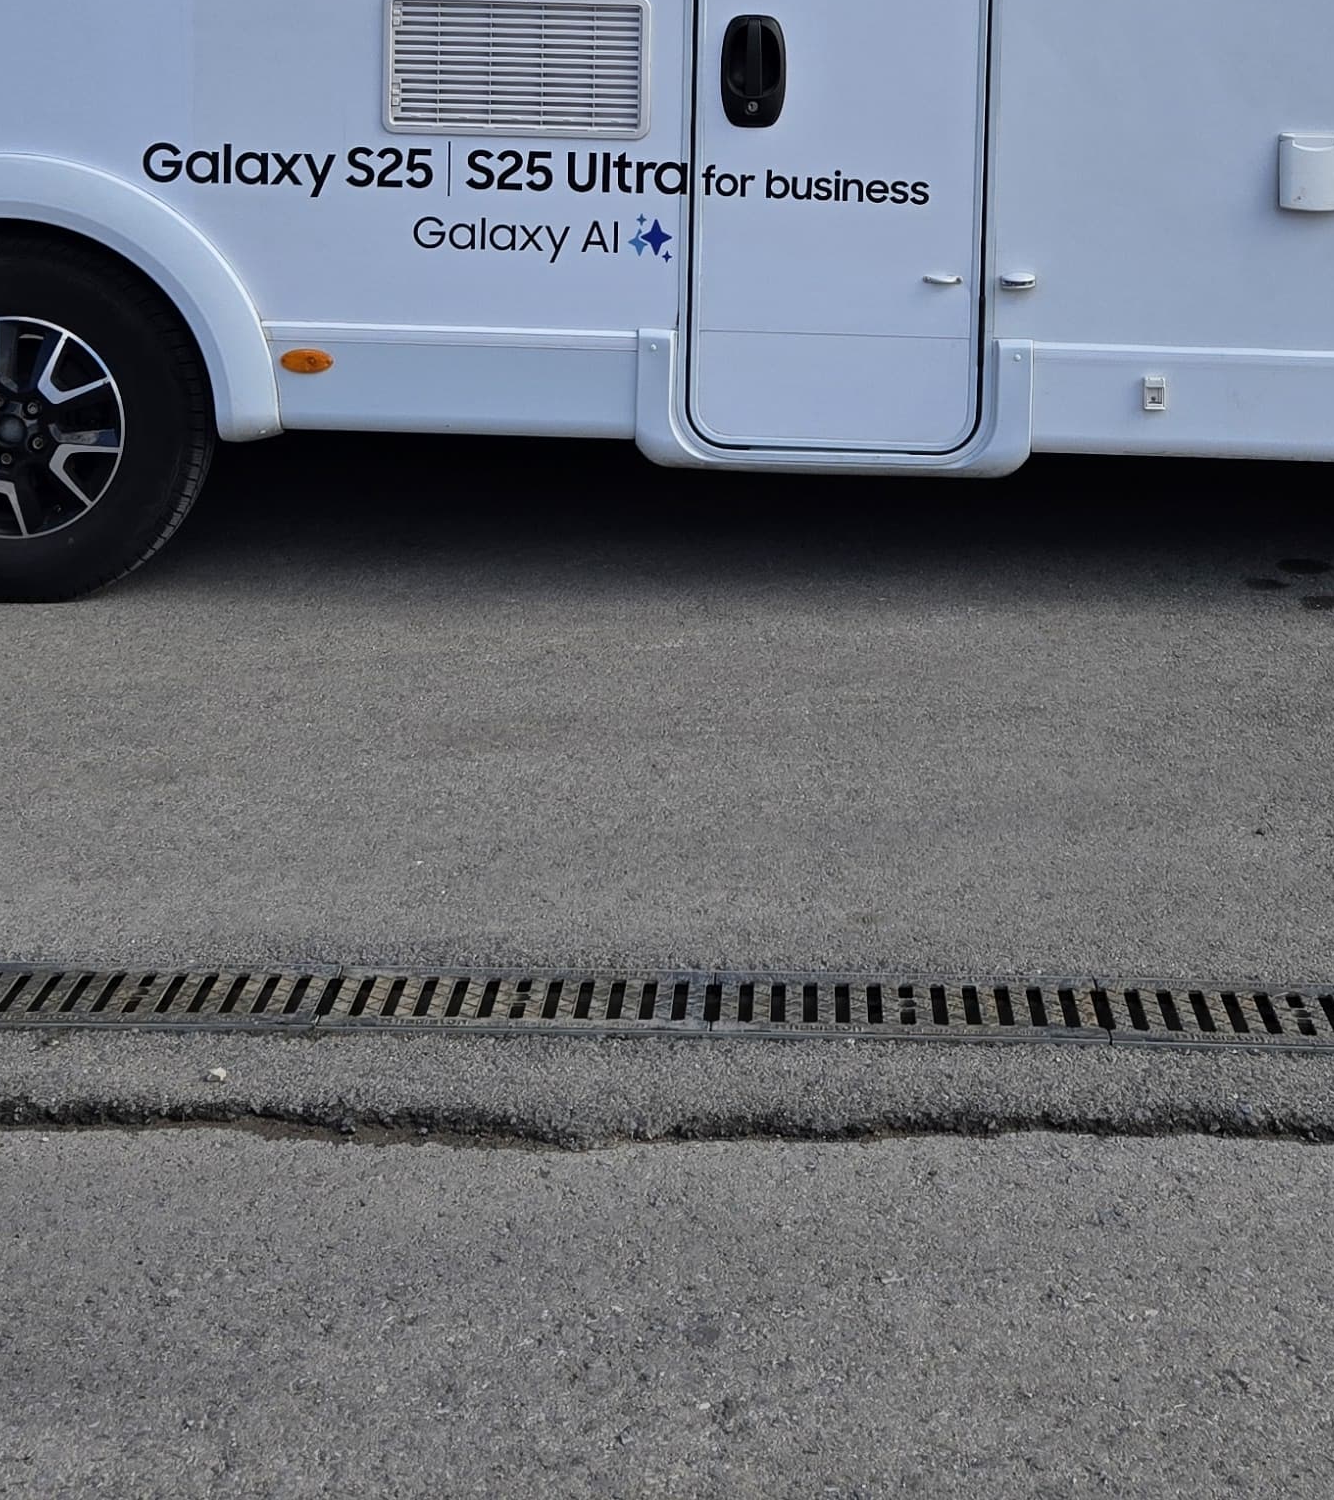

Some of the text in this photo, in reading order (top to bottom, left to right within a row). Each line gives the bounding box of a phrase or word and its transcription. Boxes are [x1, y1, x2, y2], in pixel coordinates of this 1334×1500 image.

[142, 142, 930, 206] Galaxy S25 S25 Ultra for business
[413, 216, 619, 264] Galaxy AI
